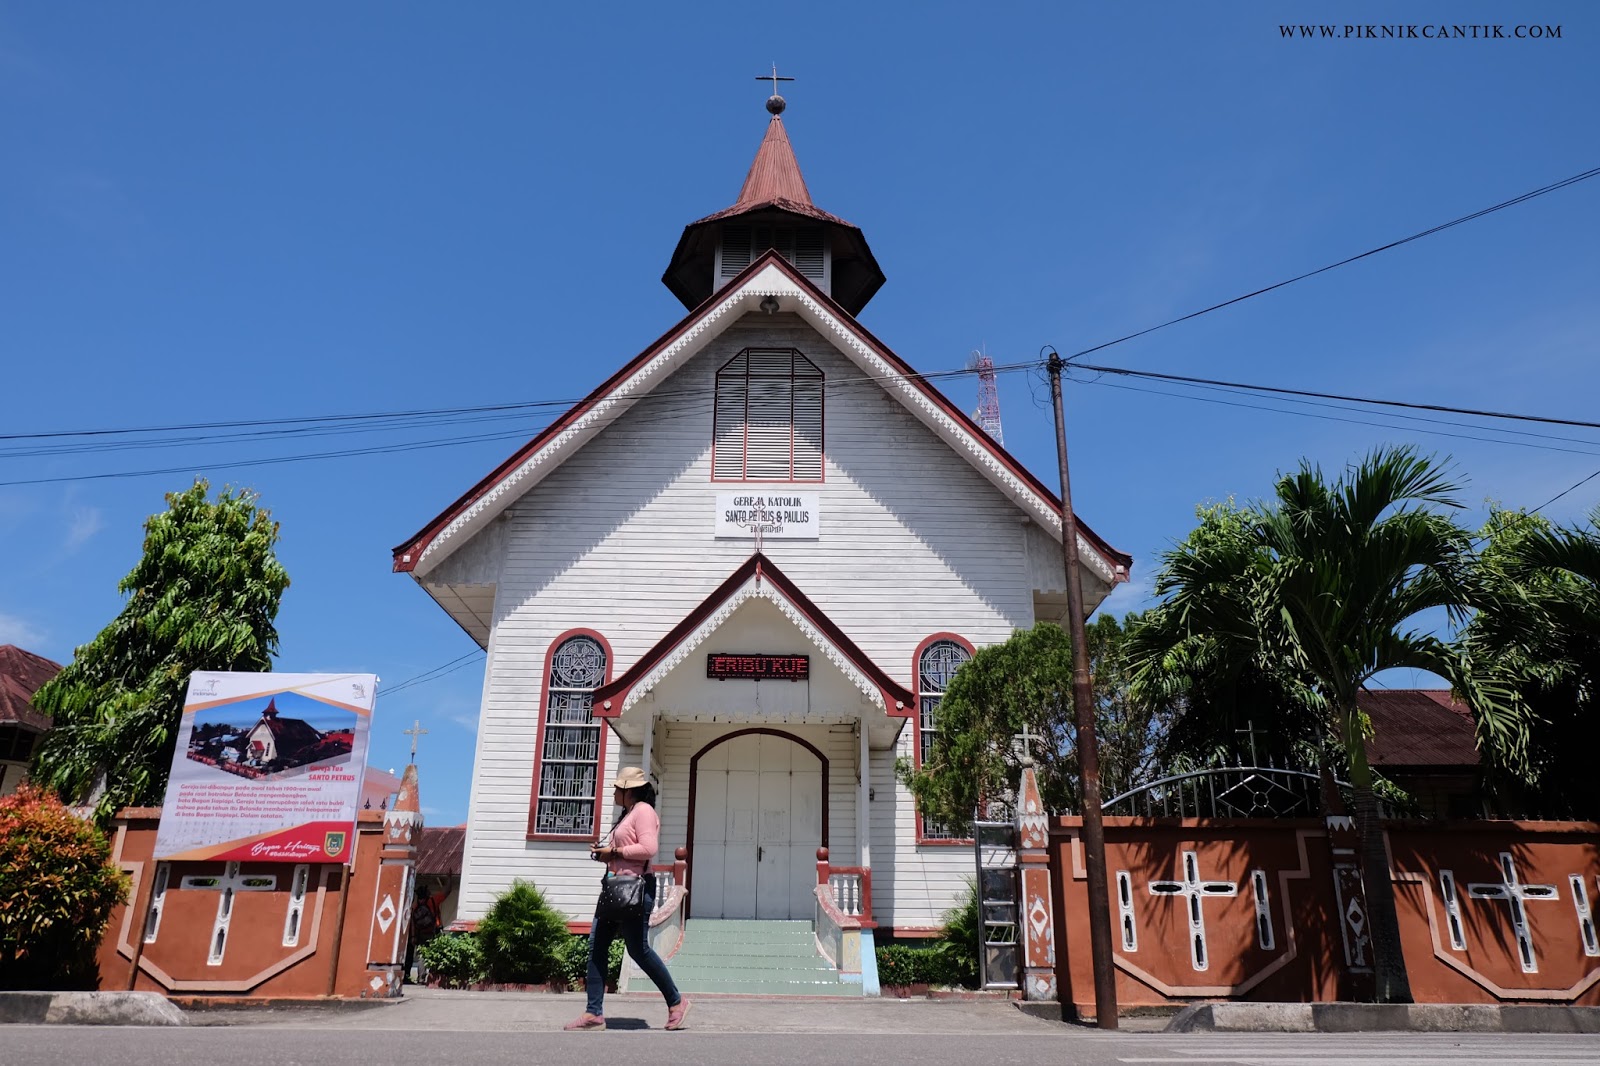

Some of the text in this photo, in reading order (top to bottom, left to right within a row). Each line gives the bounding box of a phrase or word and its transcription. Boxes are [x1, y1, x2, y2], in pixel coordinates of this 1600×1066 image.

[733, 496, 802, 508] GEREJA KATOLIK
[725, 510, 809, 524] SANTO PERUS & PAULUS
[711, 659, 808, 673] ERIBU KUE
